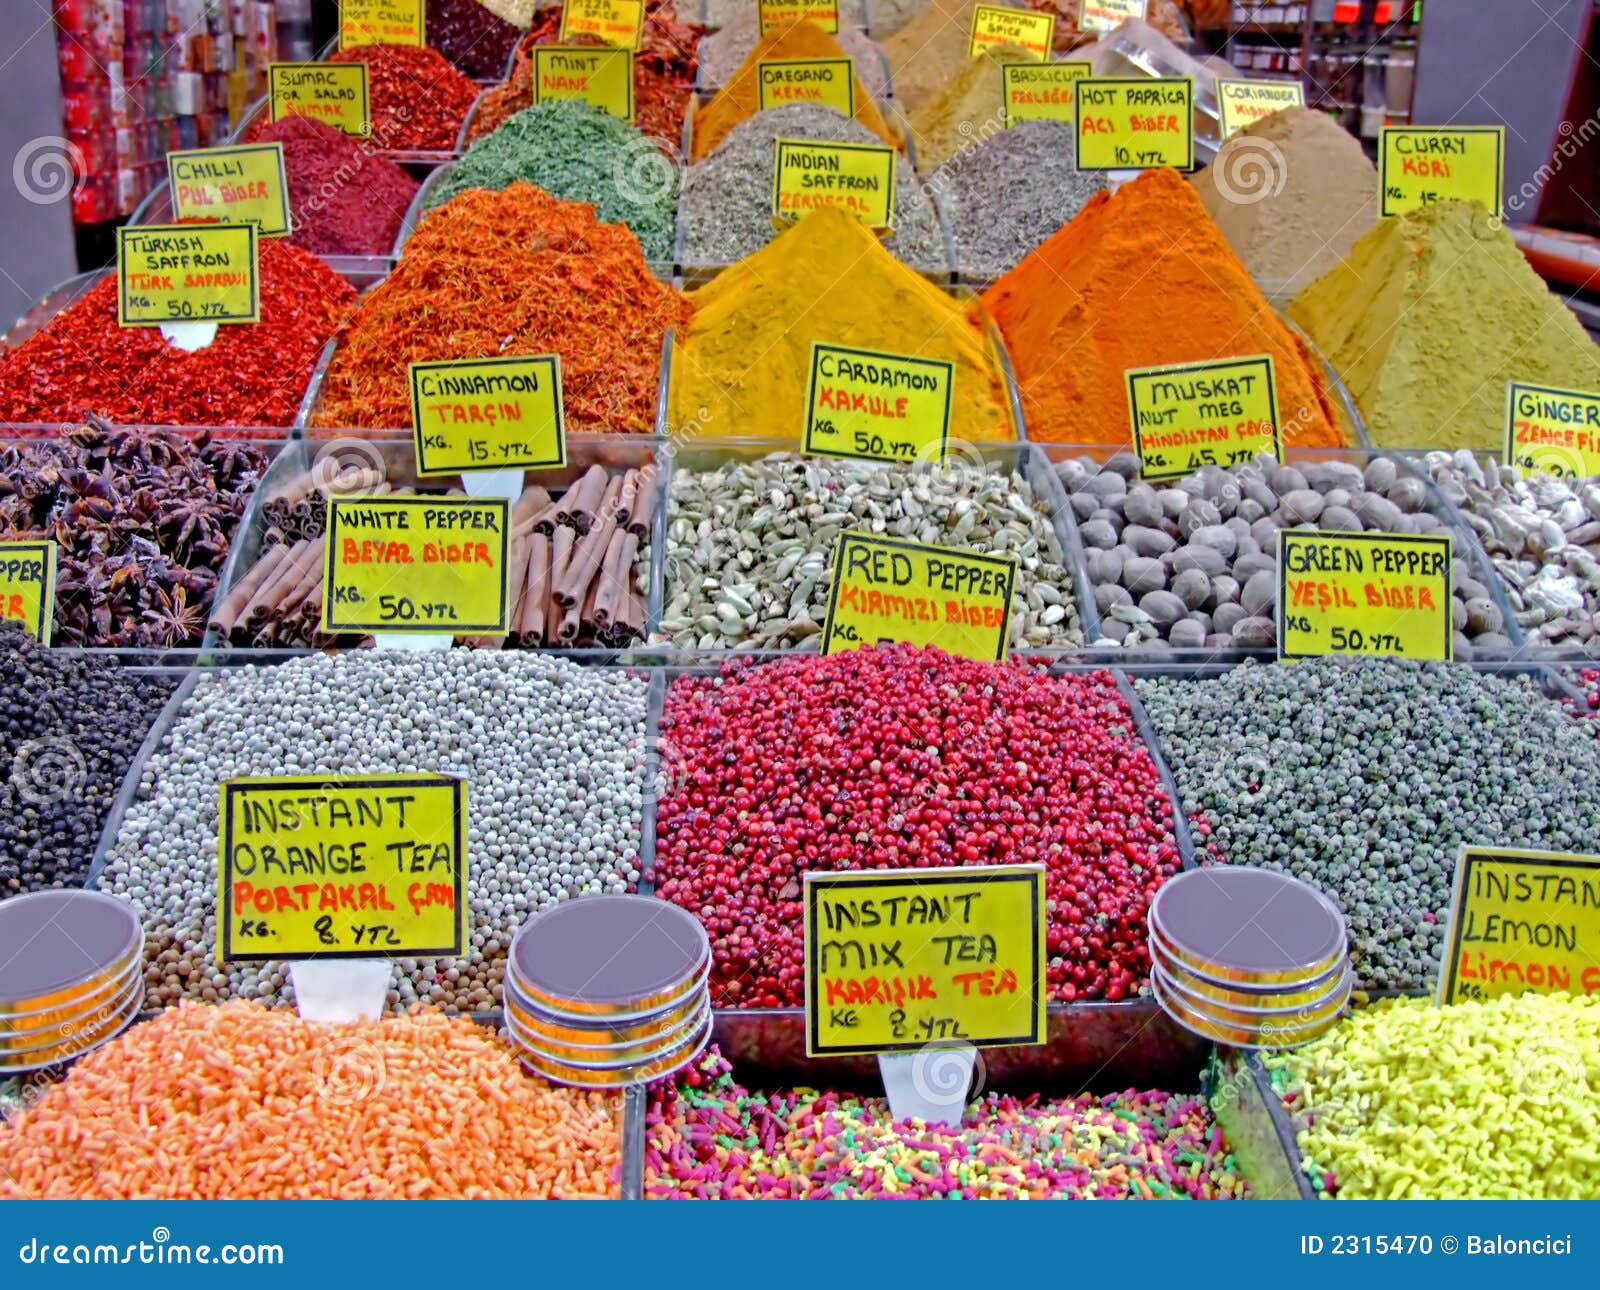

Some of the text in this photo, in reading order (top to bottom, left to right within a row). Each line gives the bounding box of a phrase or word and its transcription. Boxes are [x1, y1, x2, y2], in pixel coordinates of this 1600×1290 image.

[550, 55, 600, 71] MINT
[763, 68, 833, 84] OREGANO
[280, 71, 338, 86] SUMAC
[543, 74, 589, 92] NANE
[275, 88, 356, 101] FOR SALAD
[1081, 86, 1186, 107] HOT PAPRICA
[1223, 84, 1296, 101] CORIANDER
[1081, 115, 1116, 137] ACI
[1395, 135, 1465, 155] CURRY
[176, 160, 244, 180] CHILLI
[801, 173, 879, 192] SAFFRON
[178, 183, 214, 207] PUL
[146, 251, 230, 271] SAFFRON
[819, 355, 938, 392] CARDAMON
[818, 385, 909, 419] KAKULE
[1151, 375, 1257, 405] MUSKAT
[426, 400, 522, 428] TARÇIN
[1139, 401, 1244, 427] NUT MEG
[337, 508, 500, 534] WHITE PEPPER
[342, 537, 415, 566] BEYAZ
[1286, 542, 1447, 578] GREEN PEPPER
[847, 544, 1008, 600] RED PEPPER
[838, 582, 939, 622] KIRMIZI
[232, 840, 452, 876] ORANGE TEA
[233, 880, 396, 916] PORTAKAL
[823, 891, 982, 932] INSTANT
[1462, 910, 1577, 953] LEMON
[820, 933, 998, 974] MIX TEA
[951, 968, 1019, 998] TEA
